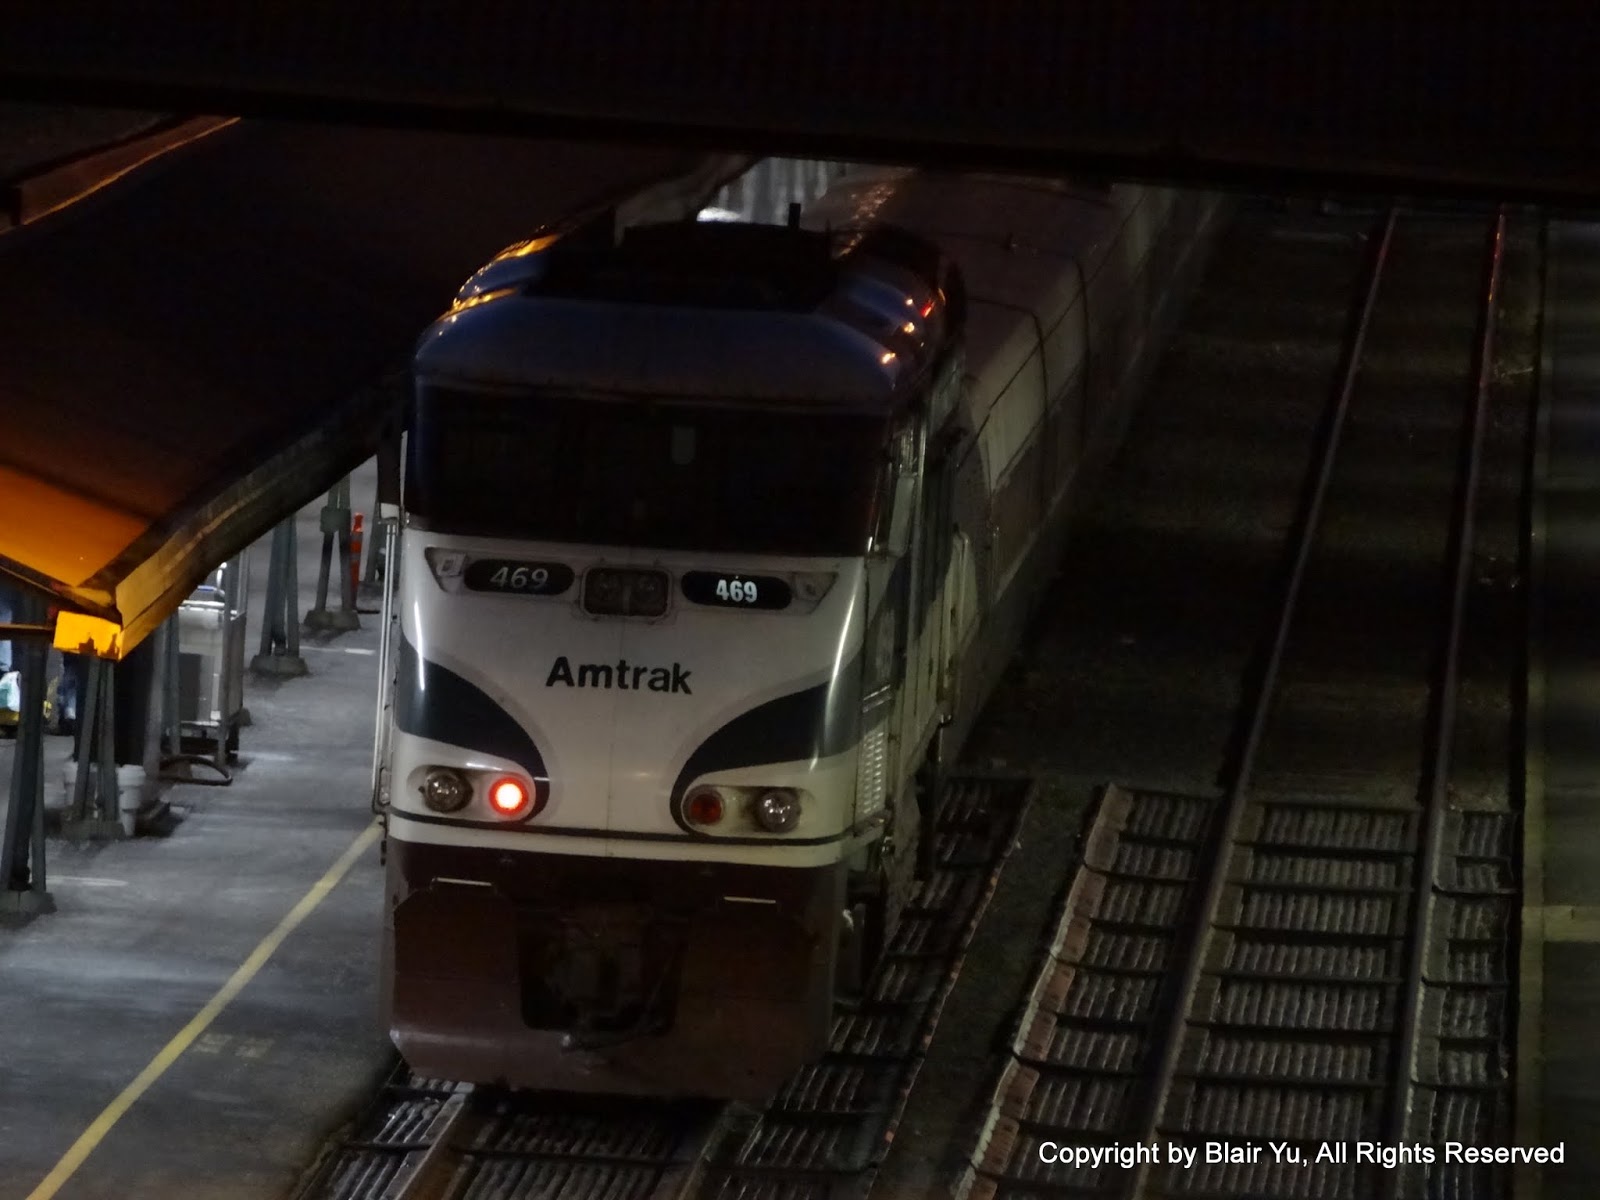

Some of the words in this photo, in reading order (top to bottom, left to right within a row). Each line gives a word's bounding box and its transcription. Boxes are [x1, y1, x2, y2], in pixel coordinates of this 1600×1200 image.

[489, 566, 549, 590] 469
[716, 578, 758, 603] 469
[545, 656, 692, 695] Amtrak
